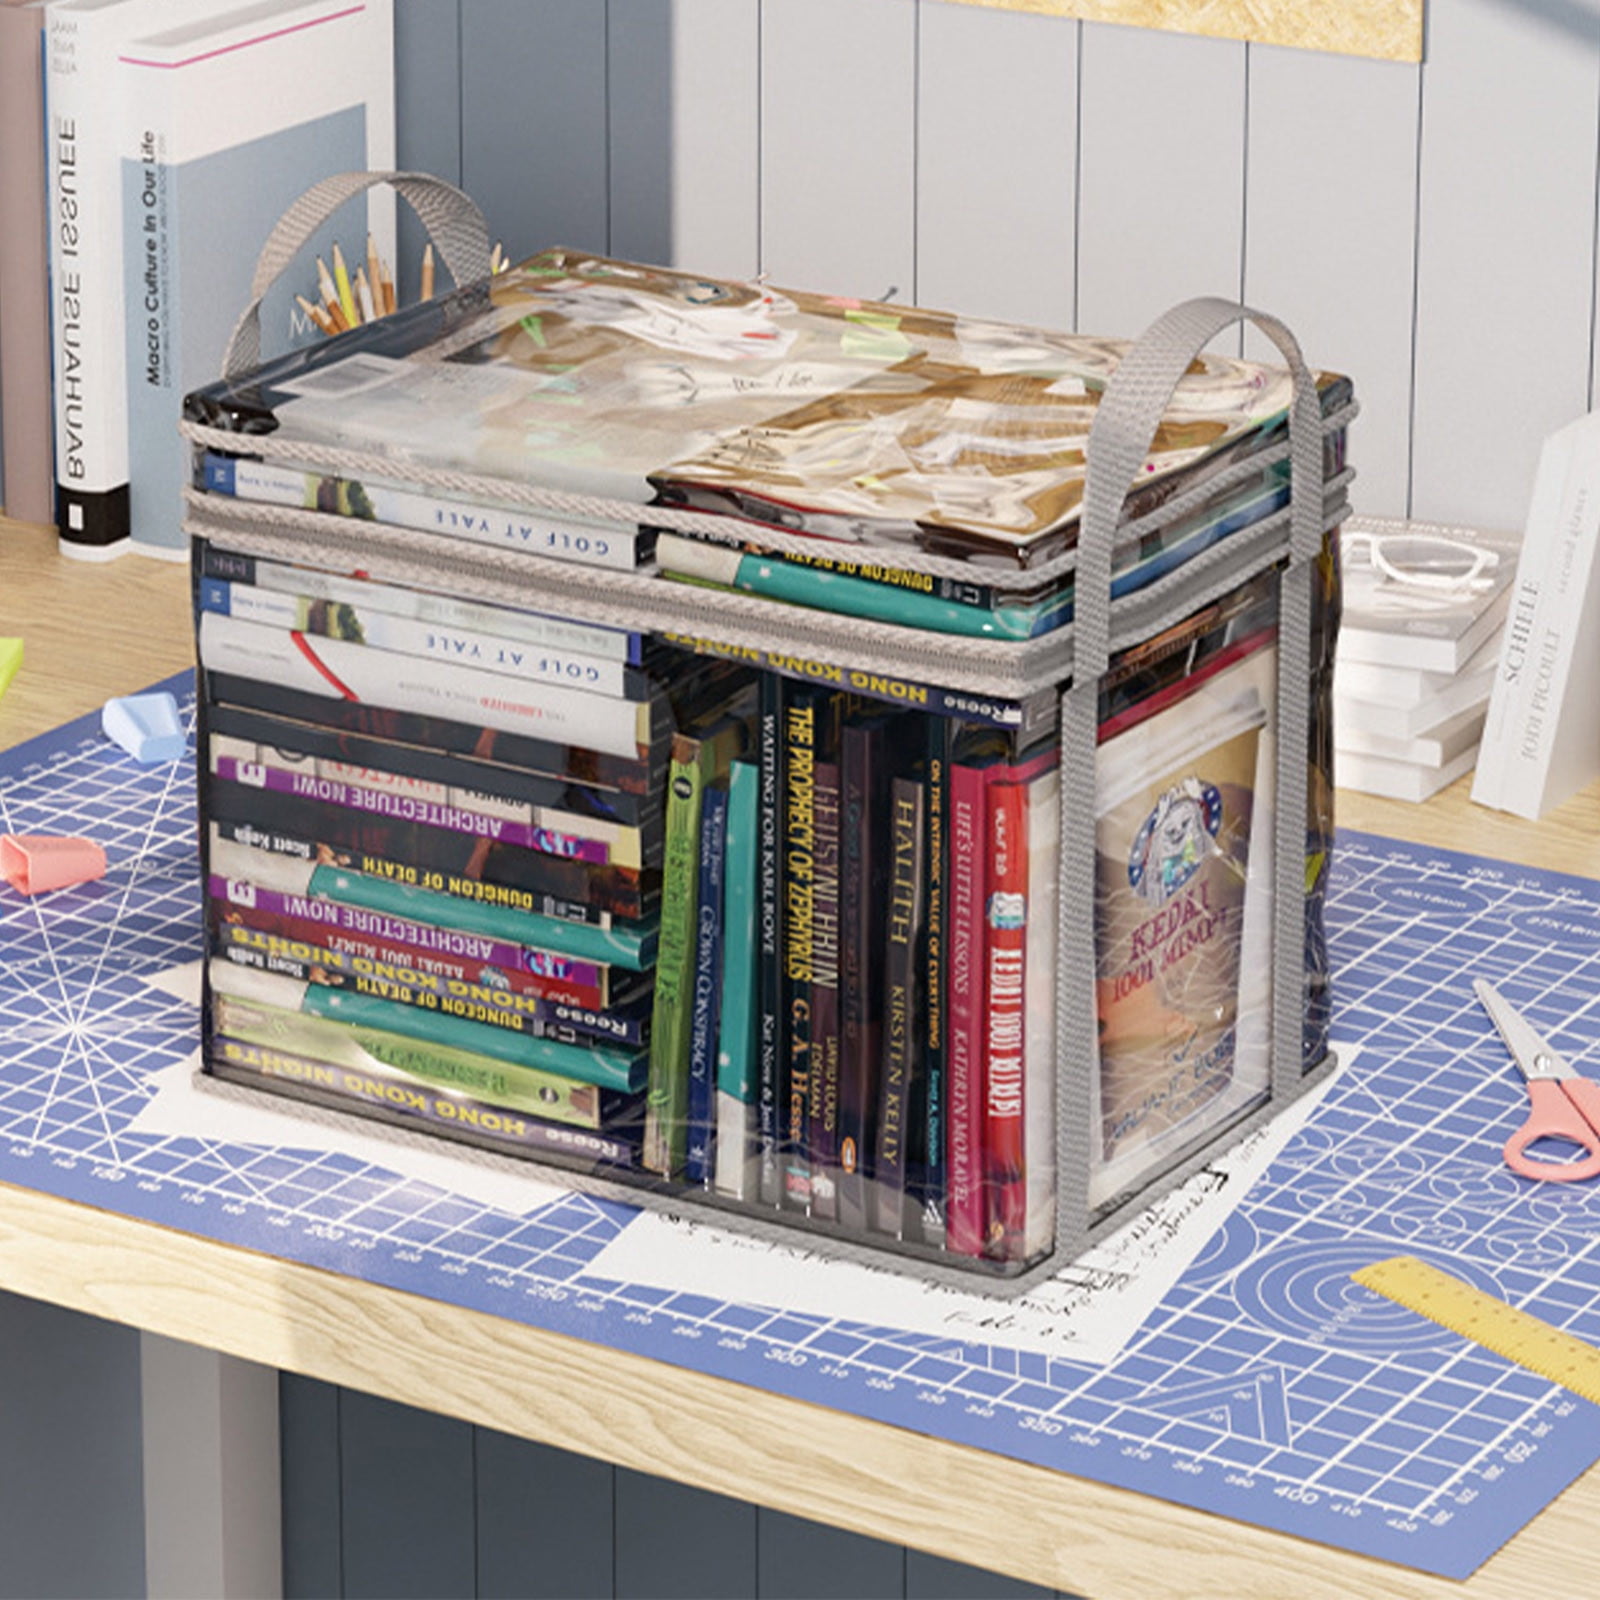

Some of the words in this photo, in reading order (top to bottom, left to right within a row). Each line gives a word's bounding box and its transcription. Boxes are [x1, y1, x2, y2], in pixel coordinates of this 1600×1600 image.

[141, 131, 157, 164] Life
[142, 170, 157, 208] Our
[144, 214, 158, 232] In
[145, 239, 161, 312] Culture
[147, 318, 161, 386] Macro
[435, 510, 489, 533] YALE
[505, 524, 532, 540] AT
[548, 532, 609, 556] GOLF
[427, 634, 481, 656] YALE
[497, 650, 523, 665] AT
[539, 659, 600, 682] GOLF
[766, 652, 843, 684] KONG
[1530, 628, 1561, 712] PICOULT
[850, 672, 928, 704] HONG
[788, 706, 814, 746] THE
[762, 714, 775, 803] WAITING
[930, 759, 942, 782] ON
[292, 774, 347, 804] NOW!
[788, 746, 814, 851] PROPHECY
[930, 785, 941, 813] THE
[350, 786, 503, 838] ARCHITECTURE
[762, 806, 775, 848] FOR
[956, 801, 974, 855] LIFE'S
[788, 851, 814, 881] OF
[930, 816, 941, 885] INTRINSIC
[362, 857, 417, 884] DEATH
[420, 870, 444, 890] OF
[762, 850, 775, 898] KARL
[955, 854, 972, 919] LITTLE
[283, 895, 338, 924] NOW!
[448, 877, 533, 910] DUNGEON
[928, 888, 940, 932] VALUE
[343, 904, 494, 960] ARCHITECTURE
[762, 901, 775, 954] ROVE
[787, 881, 814, 982] ZEPHYRUS
[1129, 880, 1210, 965] KEDAI
[231, 927, 343, 968] NIGHTS
[928, 935, 939, 957] OF
[954, 919, 972, 996] LESSONS
[351, 957, 439, 991] KONG
[356, 976, 412, 1000] DEATH
[989, 946, 1023, 1005] KEDAI
[416, 989, 438, 1010] OF
[440, 996, 524, 1030] DUNGEON
[447, 979, 537, 1014] HONG
[792, 998, 810, 1027] G.
[928, 958, 940, 1050] EVERYTHING
[555, 1007, 628, 1037] Reese
[692, 974, 715, 1082] CONSPIRACY
[763, 1012, 775, 1041] Kat
[888, 985, 906, 1084] KIRSTEN
[224, 1044, 335, 1086] NIGHTS
[791, 1036, 809, 1061] A.
[953, 1027, 970, 1118] KATHRYN
[987, 1054, 1022, 1118] MIMPI
[343, 1074, 427, 1111] KONG
[762, 1087, 774, 1101] &
[789, 1068, 809, 1142] Hesse
[435, 1100, 526, 1137] HONG
[882, 1093, 901, 1167] KELLY
[545, 1128, 619, 1158] Reese
[303, 1223, 345, 1241] 200
[763, 1348, 807, 1367] 300
[819, 1364, 850, 1379] 310
[865, 1377, 896, 1392] 320
[964, 1403, 996, 1418] 340
[1017, 1416, 1064, 1437] 350
[1120, 1446, 1153, 1461] 370
[1224, 1473, 1256, 1489] 390
[1272, 1484, 1320, 1506] 400
[1329, 1501, 1363, 1517] 410
[1385, 1517, 1419, 1533] 420
